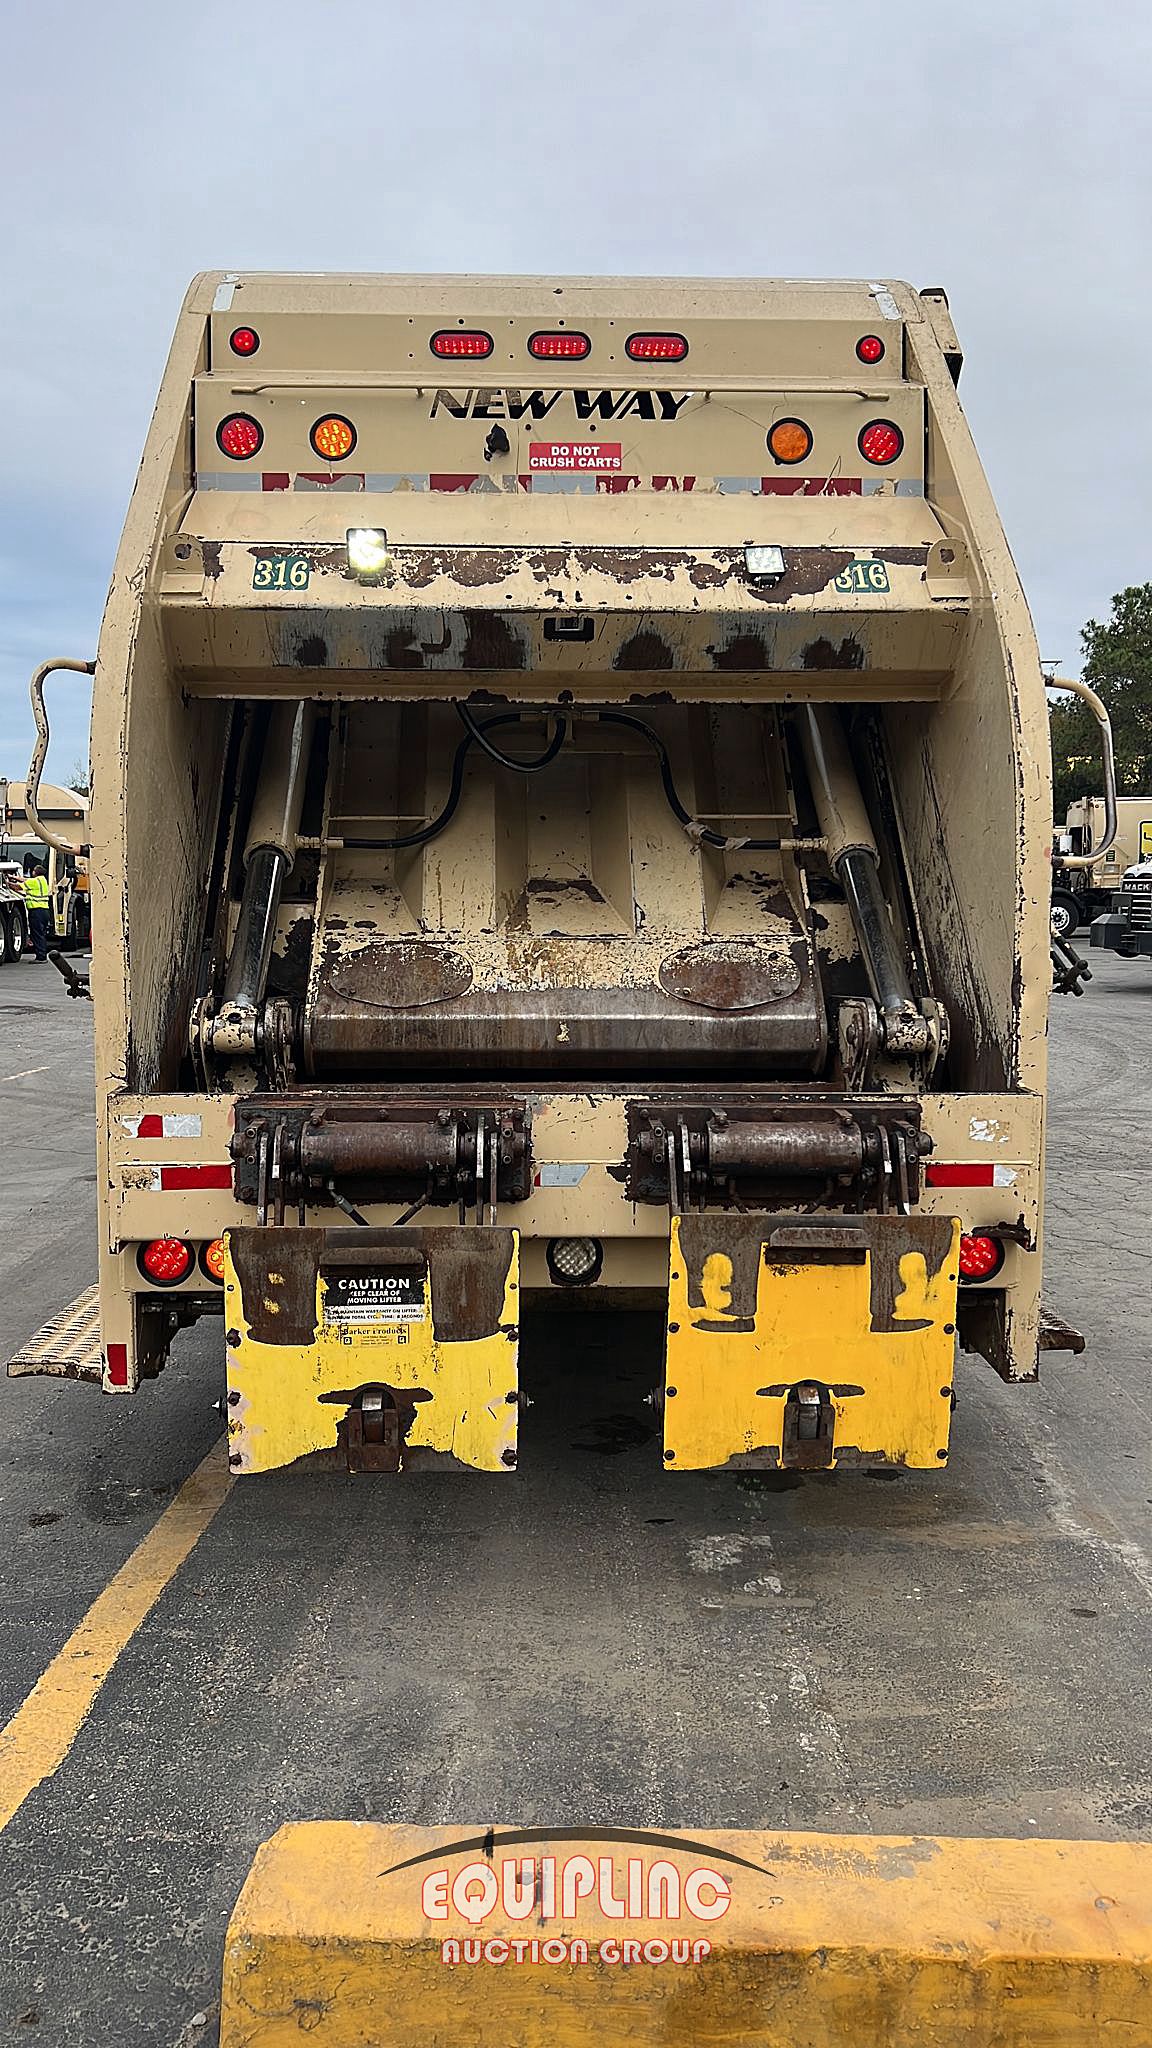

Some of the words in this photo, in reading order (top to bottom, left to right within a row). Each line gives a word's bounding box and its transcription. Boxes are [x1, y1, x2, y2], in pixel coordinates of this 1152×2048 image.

[429, 389, 565, 419] NEW
[573, 389, 694, 420] WAY
[551, 446, 569, 456] DO
[573, 446, 600, 456] NOT
[530, 457, 575, 468] CRUSH
[578, 457, 621, 468] CARTS
[254, 560, 308, 587] 316
[836, 563, 888, 588] 316
[1124, 883, 1150, 891] MACK
[338, 1278, 410, 1290] CAUTION
